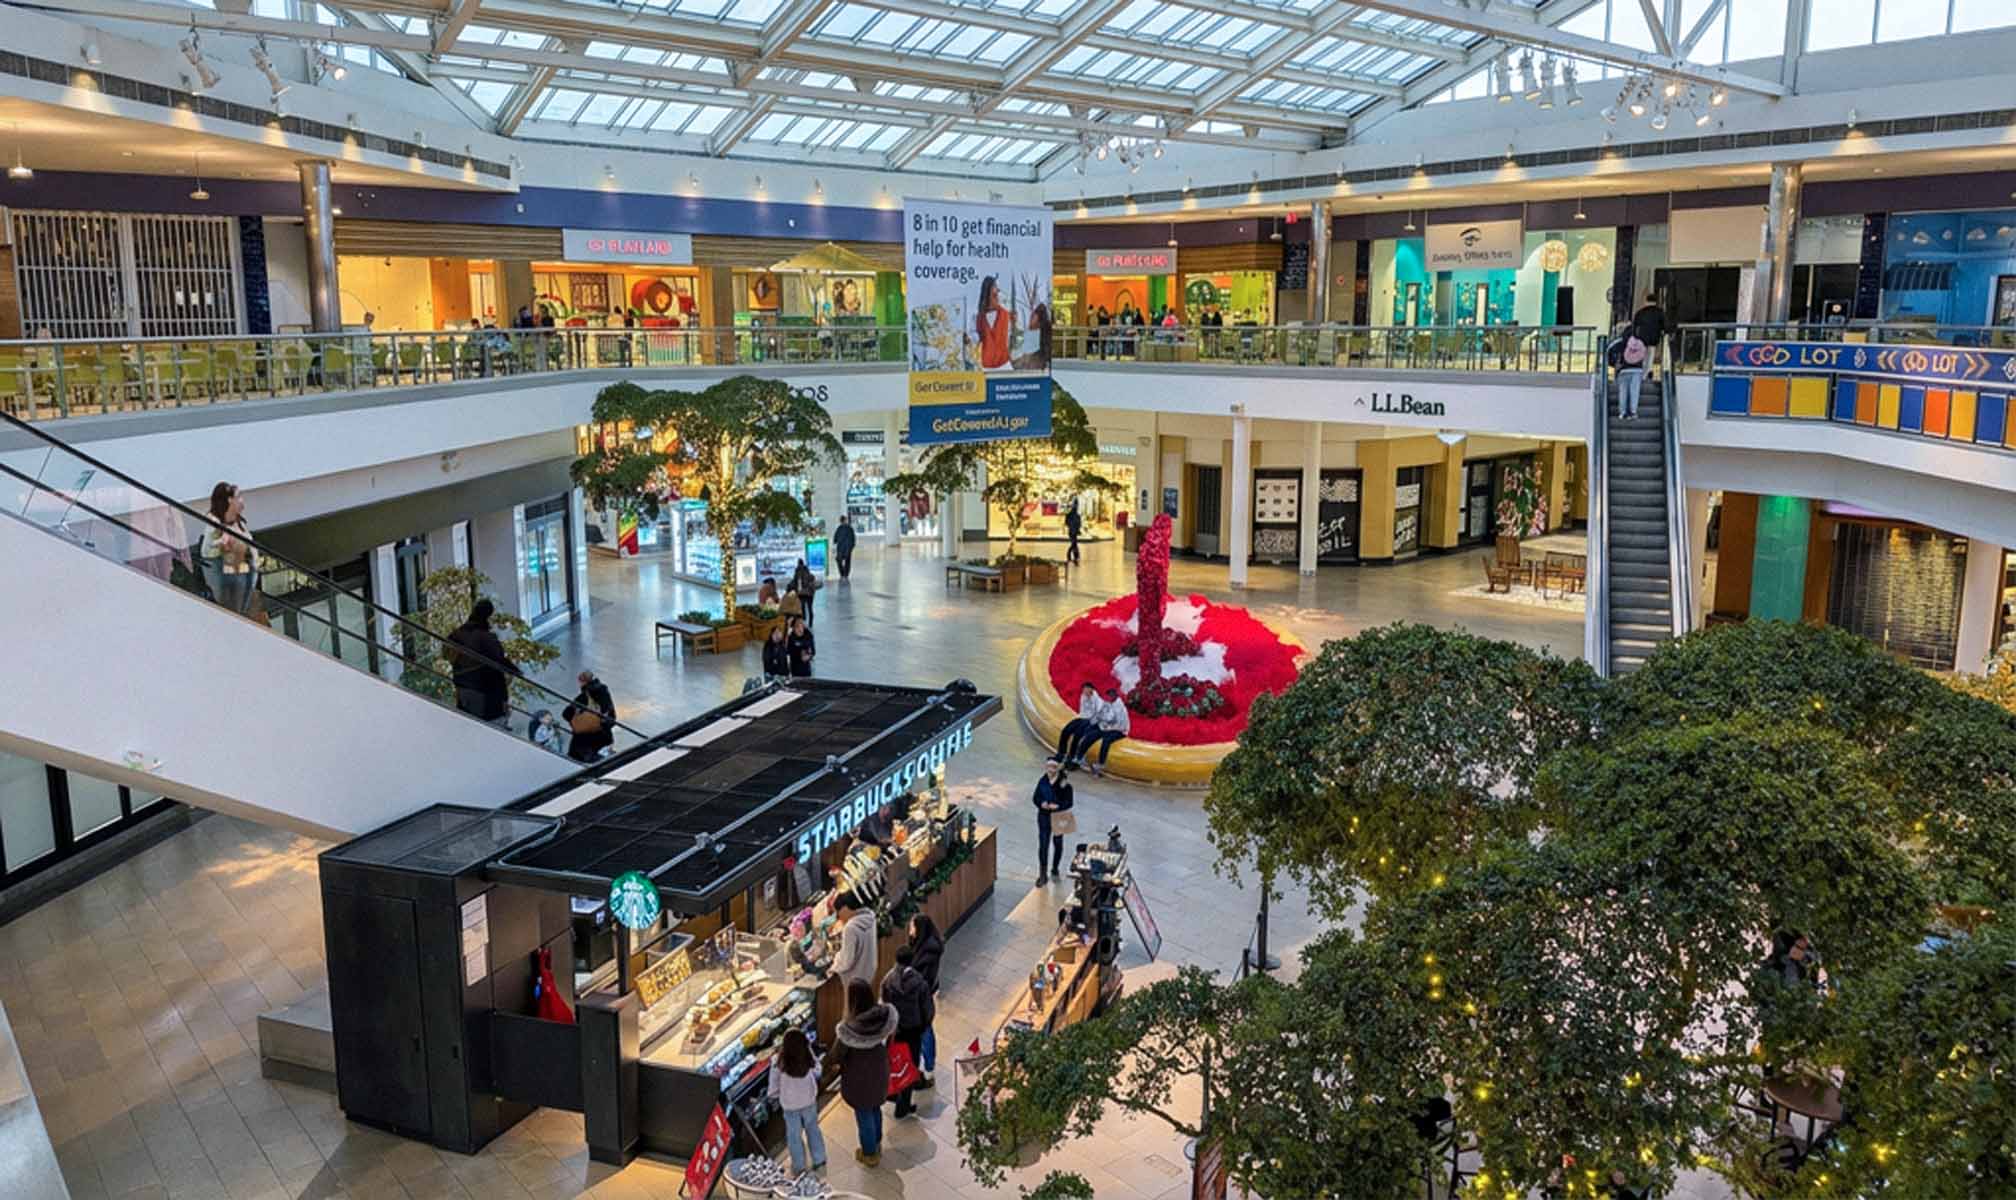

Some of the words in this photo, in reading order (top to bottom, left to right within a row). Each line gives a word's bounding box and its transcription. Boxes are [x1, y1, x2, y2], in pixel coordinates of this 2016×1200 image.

[912, 214, 923, 231] 8
[925, 214, 938, 232] in
[942, 216, 958, 232] 10
[961, 219, 983, 239] get
[986, 217, 1041, 236] financial
[913, 239, 943, 258] help
[946, 240, 965, 256] for
[968, 241, 1009, 258] health
[914, 265, 979, 285] coverage.
[1800, 348, 1842, 366] LOT
[1932, 353, 1958, 374] LOT
[1371, 392, 1446, 417] L.L.Bean
[798, 761, 915, 865] STARBUCKS
